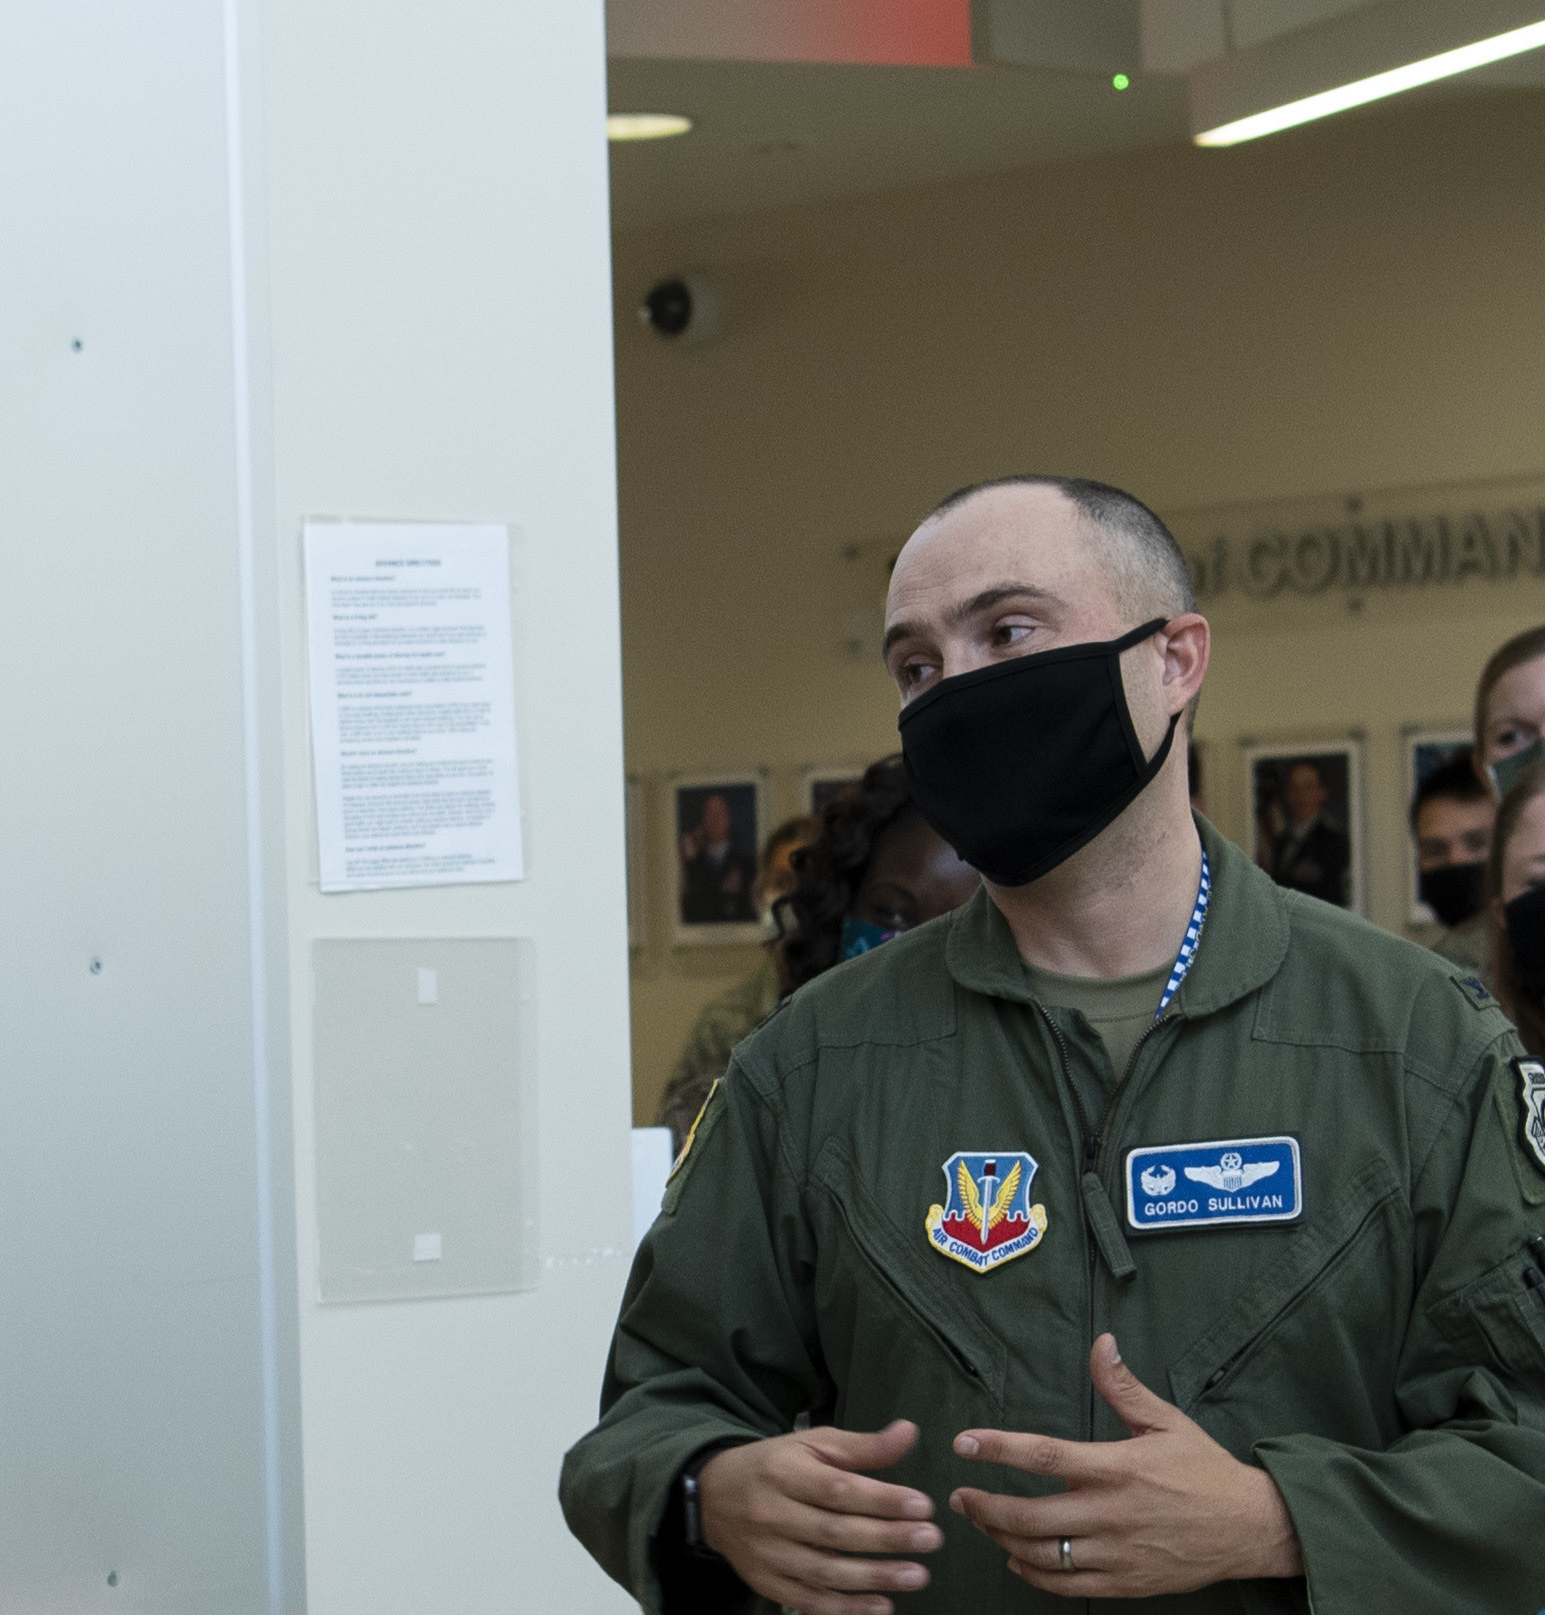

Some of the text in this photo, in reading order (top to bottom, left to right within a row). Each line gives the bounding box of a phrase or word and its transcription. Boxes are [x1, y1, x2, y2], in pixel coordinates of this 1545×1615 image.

[1144, 1194, 1283, 1216] GORDO SULLIVAN
[932, 1227, 1039, 1266] AIR COMBAT COMMAND
